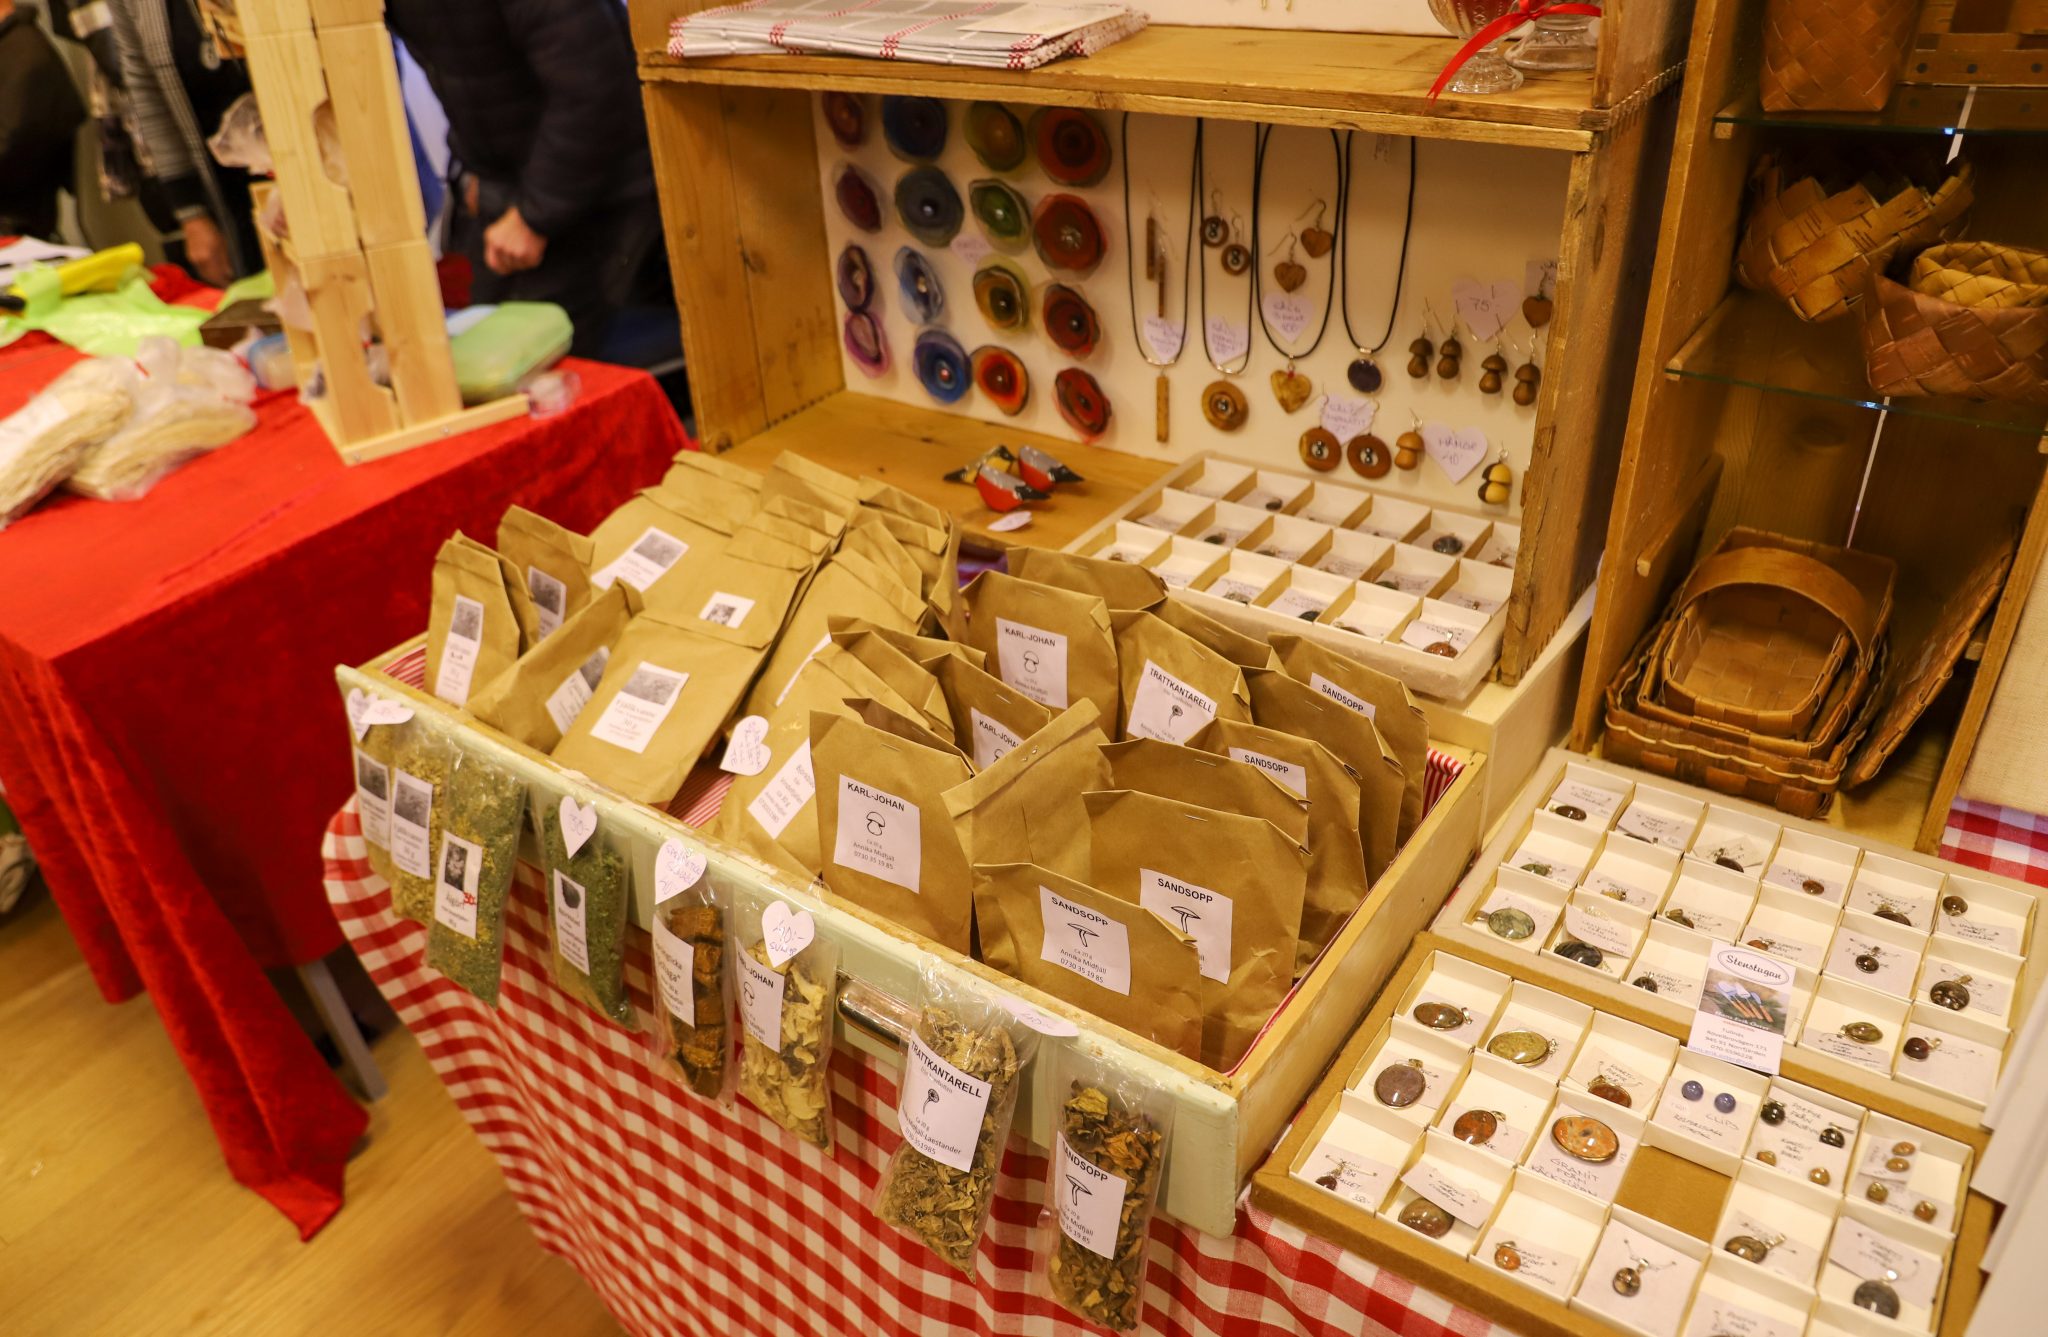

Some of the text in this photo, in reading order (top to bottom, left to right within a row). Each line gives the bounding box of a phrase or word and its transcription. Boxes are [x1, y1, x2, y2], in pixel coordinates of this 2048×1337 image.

[1005, 626, 1056, 647] KARL-JOHAN
[1149, 667, 1212, 713] TRATTKANTARELL
[1321, 684, 1364, 713] SANDSOPP
[1244, 754, 1289, 775] SANDSOPP
[847, 782, 905, 812] KARL-JOHAN
[1157, 878, 1213, 904] SANDSOPP
[1051, 896, 1109, 926] SANDSOPP
[1725, 953, 1782, 980] Stenstugan
[910, 1040, 983, 1099] TRATTKANTARELL
